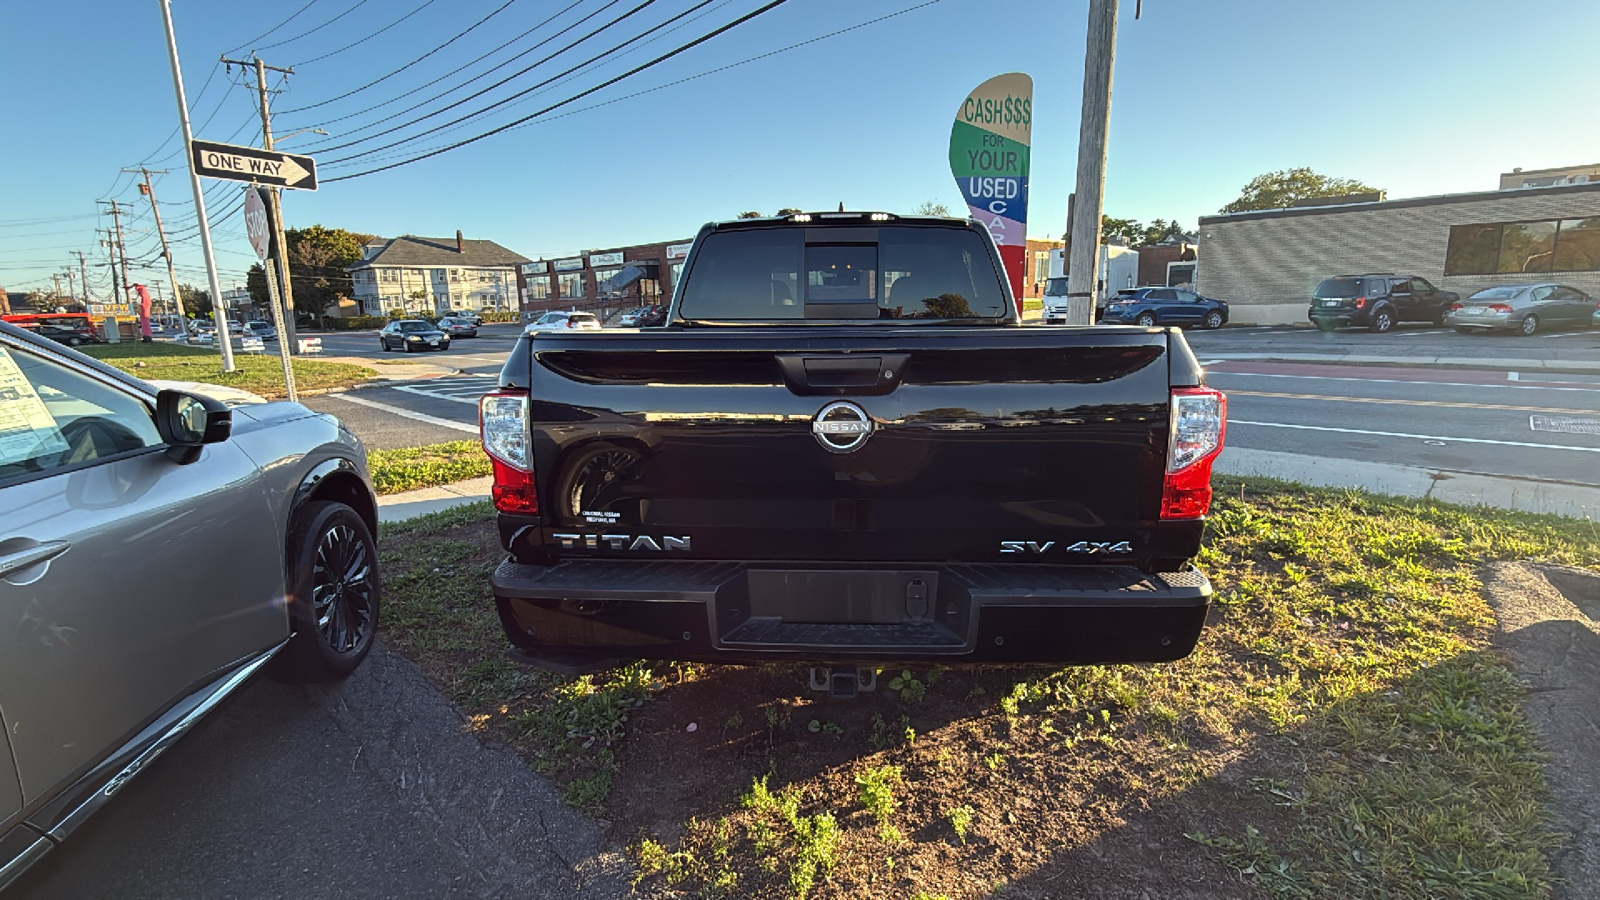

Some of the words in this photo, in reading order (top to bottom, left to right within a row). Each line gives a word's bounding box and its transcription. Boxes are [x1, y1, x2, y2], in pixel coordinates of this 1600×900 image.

[964, 94, 1031, 131] CASH$$$
[982, 134, 1004, 148] FOR
[208, 153, 243, 170] ONE
[248, 158, 282, 175] WAY
[968, 149, 1018, 172] YOUR
[969, 176, 1018, 199] USED
[246, 209, 266, 239] STOP
[103, 304, 129, 312] VFW
[815, 423, 869, 431] NISSAN
[553, 533, 691, 551] TITAN
[1000, 541, 1055, 554] SV
